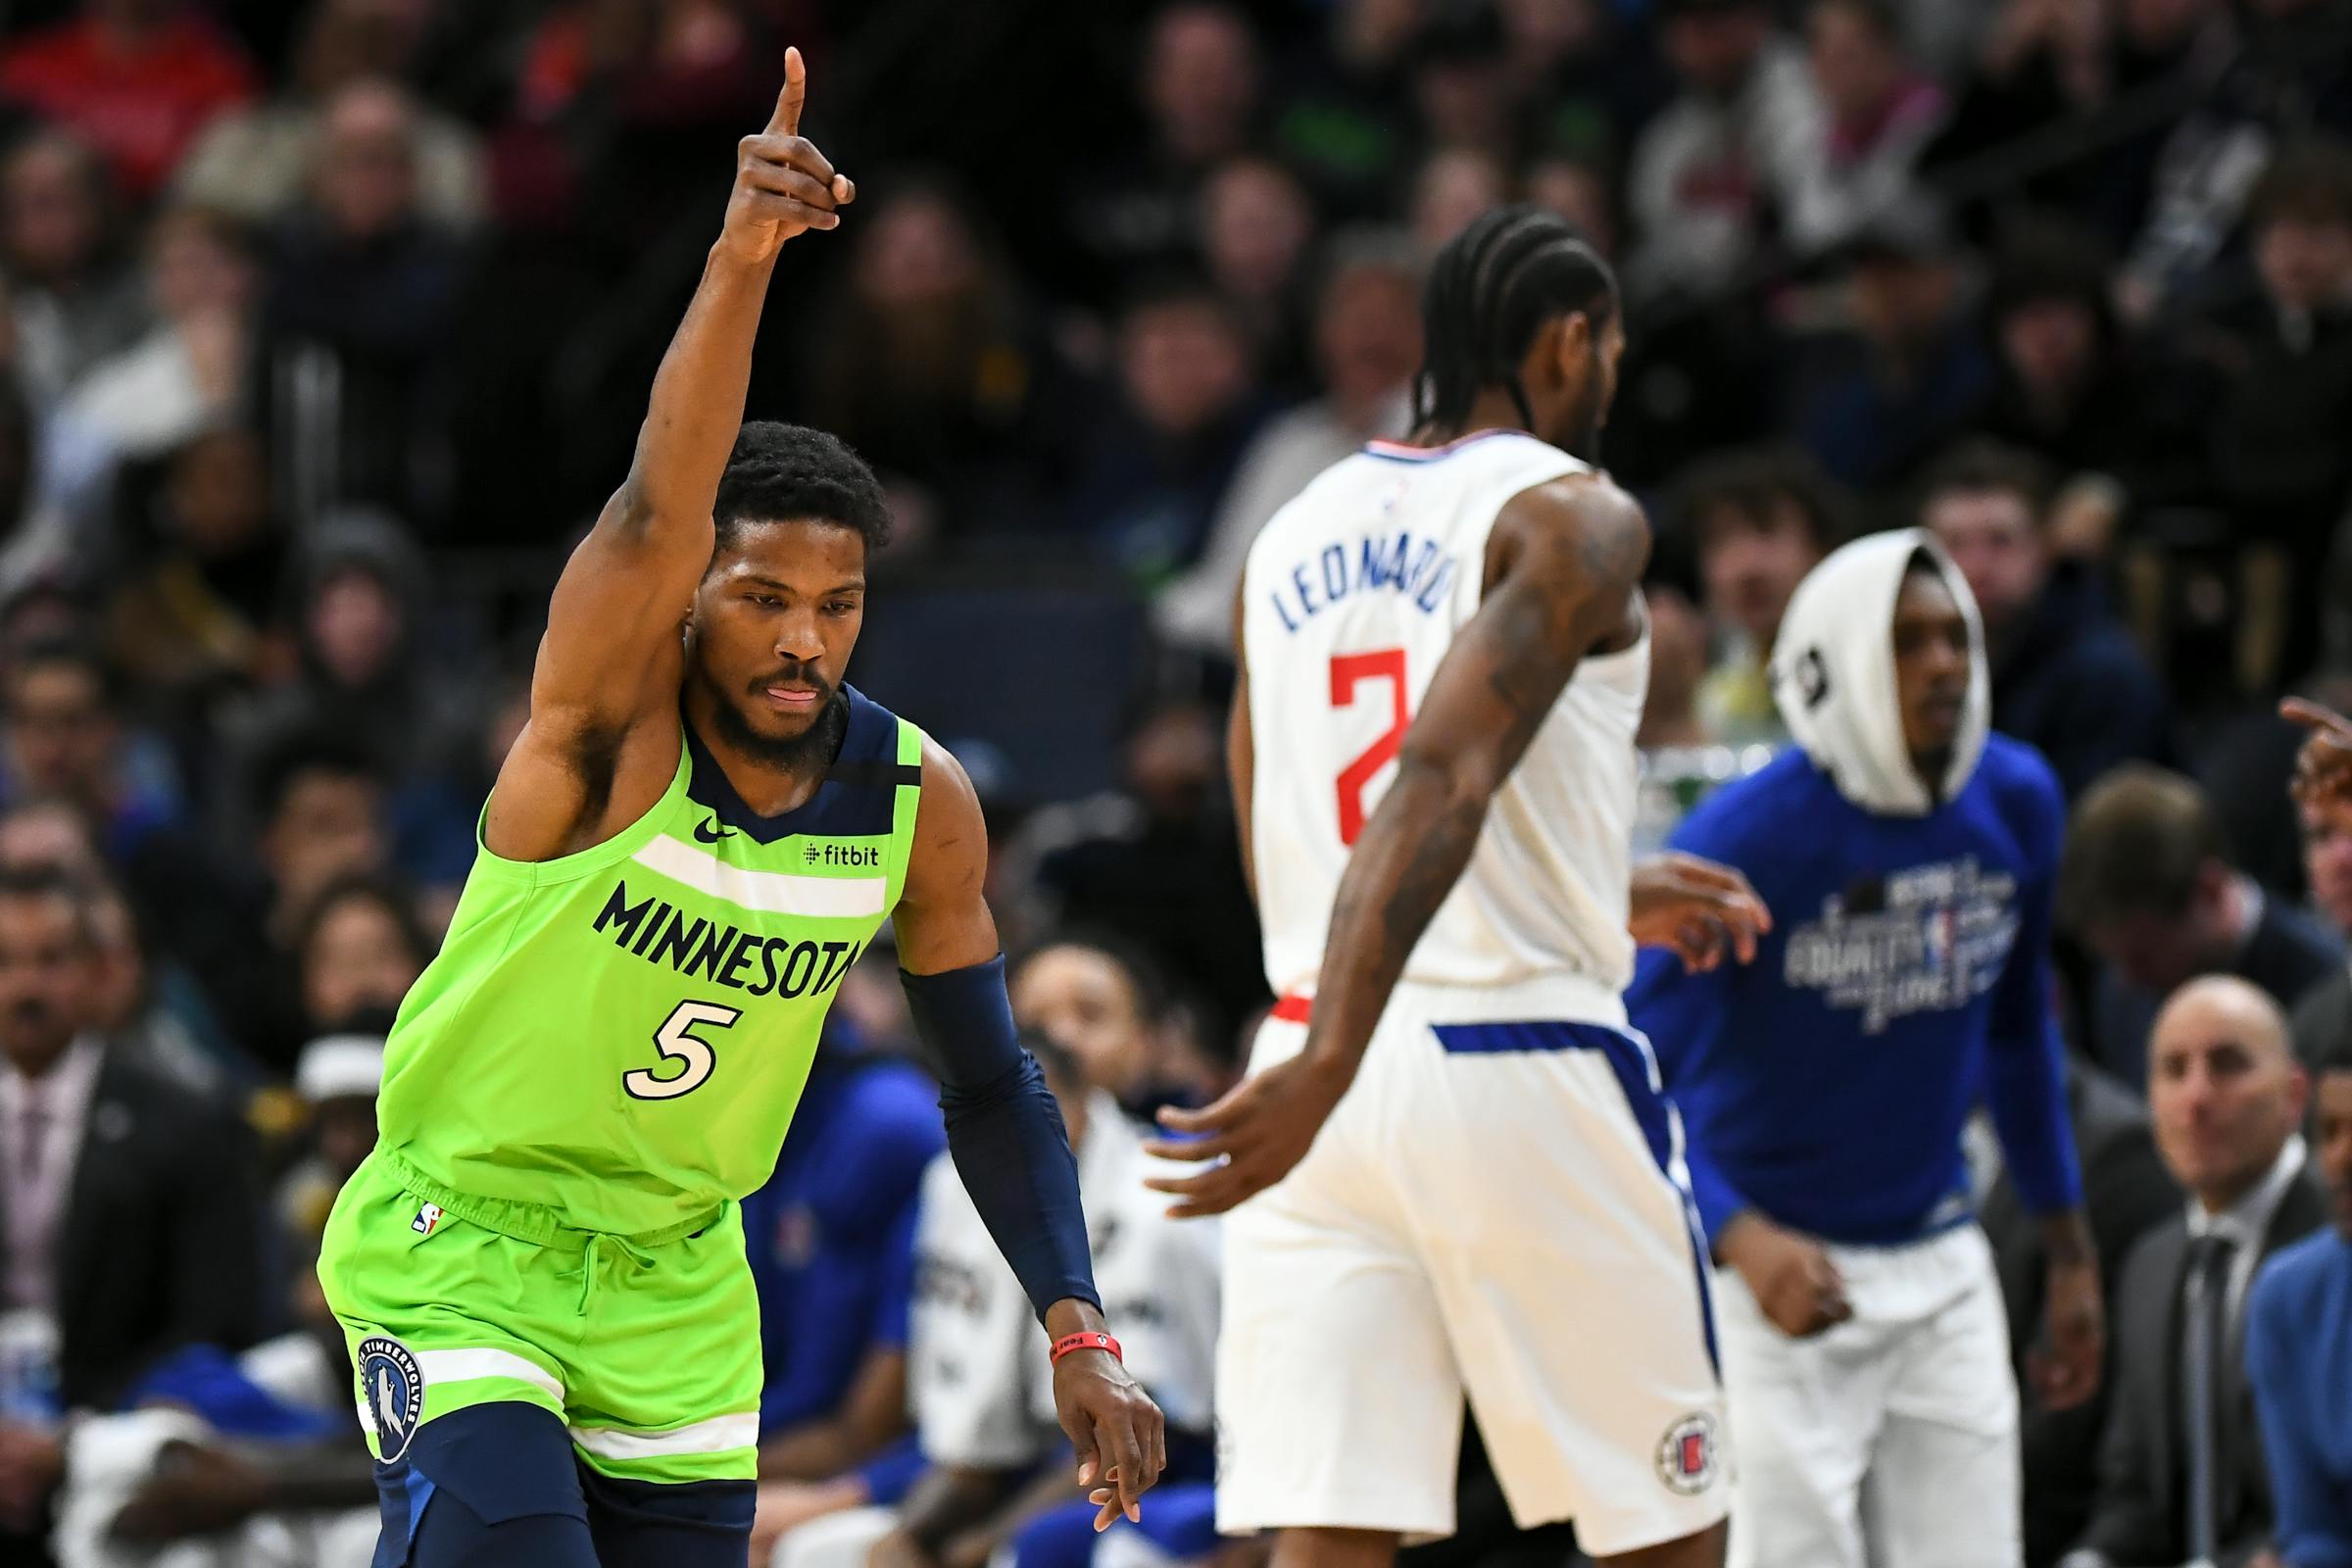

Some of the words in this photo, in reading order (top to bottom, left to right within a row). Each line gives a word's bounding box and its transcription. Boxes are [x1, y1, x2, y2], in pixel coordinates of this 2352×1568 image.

[1329, 648, 1411, 847] 2
[824, 845, 879, 866] fitbit
[622, 999, 744, 1101] 5
[365, 1341, 420, 1423] TIMBERWOLVES
